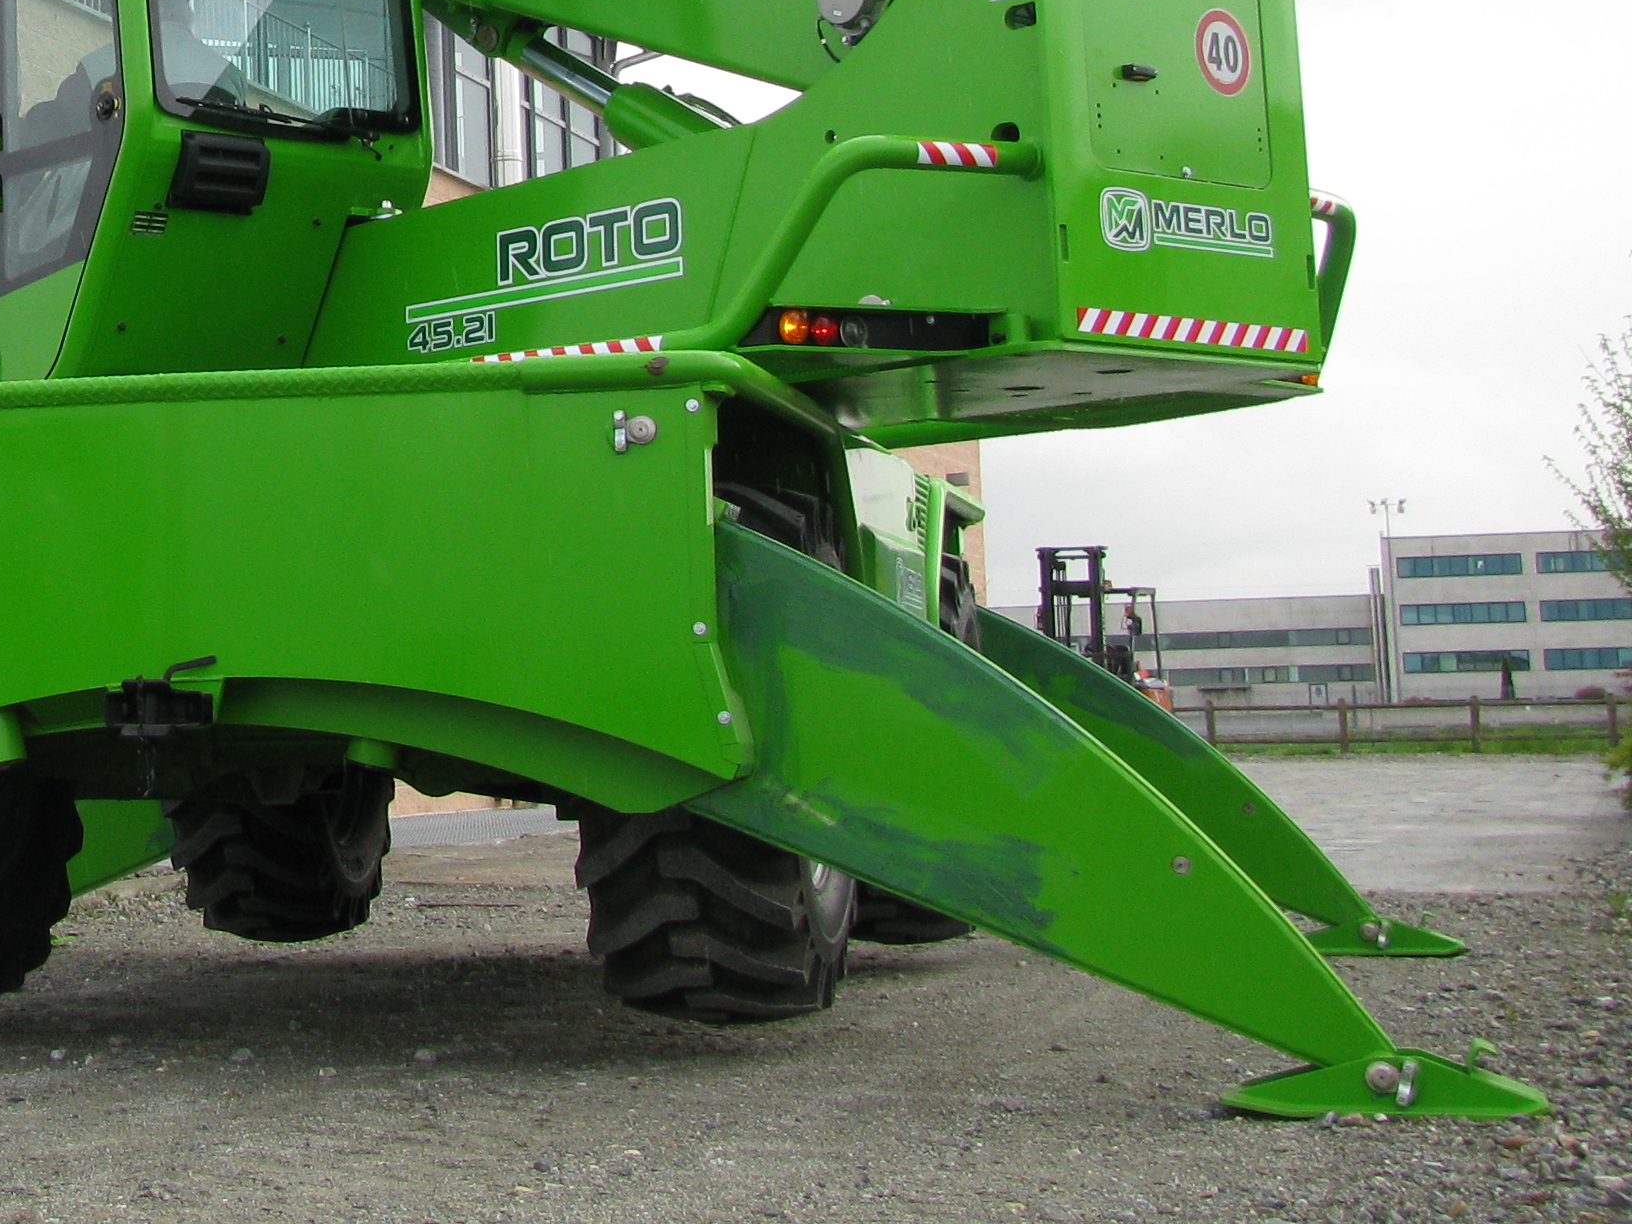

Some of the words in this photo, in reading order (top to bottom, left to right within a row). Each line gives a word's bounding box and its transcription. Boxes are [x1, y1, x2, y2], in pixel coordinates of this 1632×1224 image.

[1208, 31, 1239, 74] 40
[496, 197, 682, 287] ROTO
[1151, 199, 1272, 244] MERLO
[406, 310, 497, 354] 45.21
